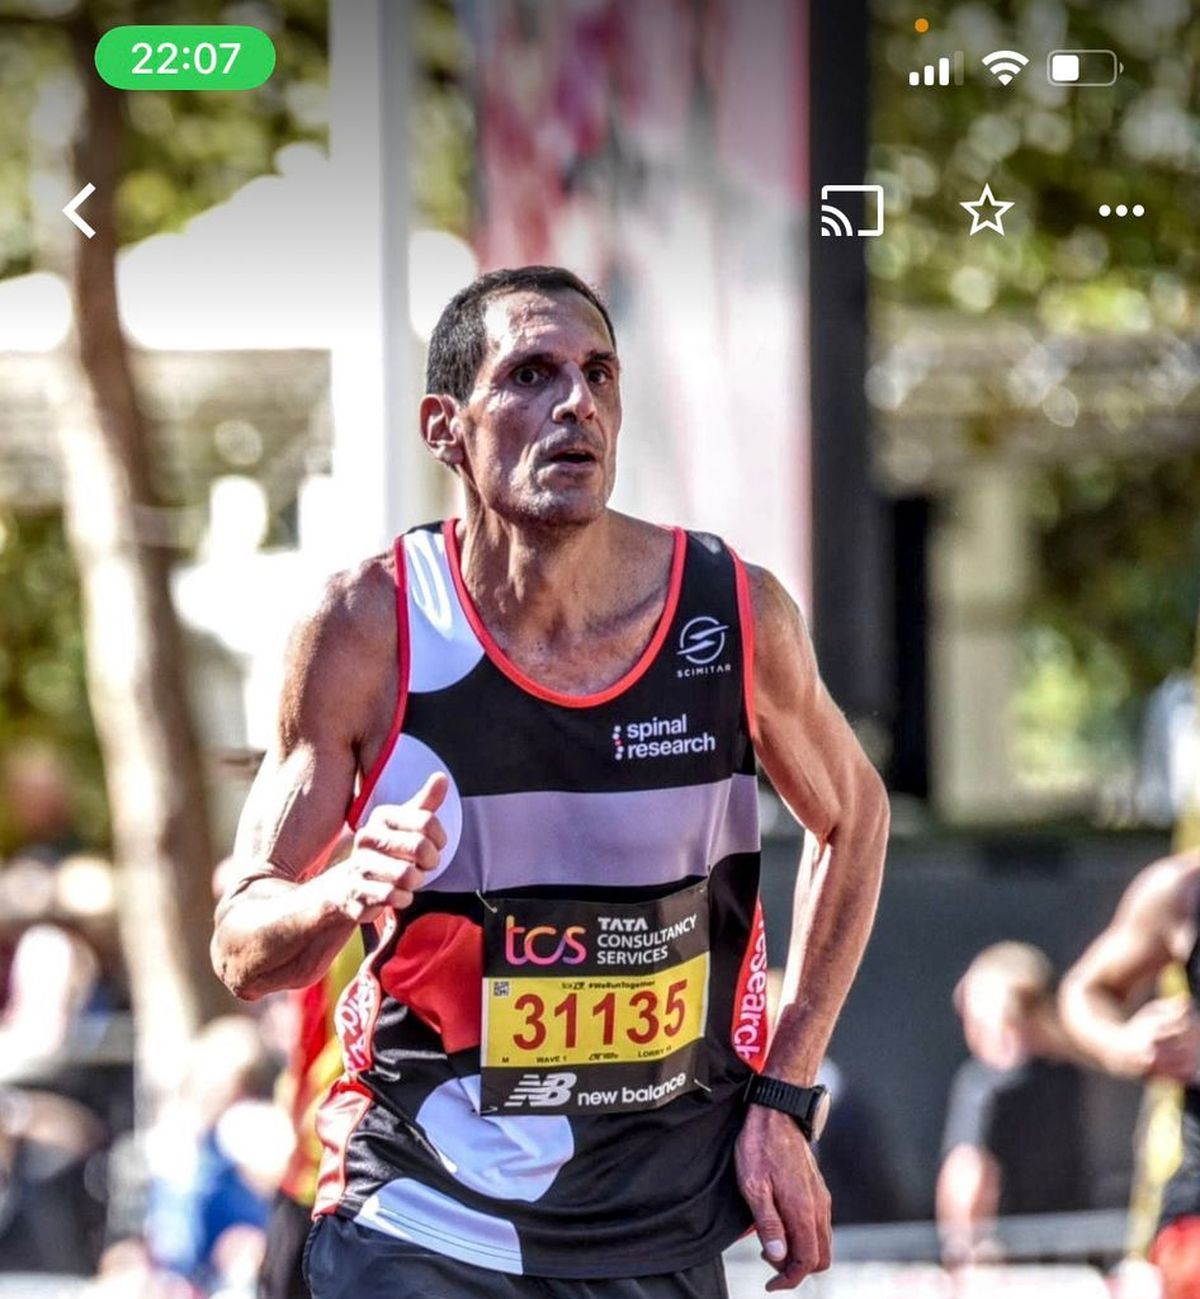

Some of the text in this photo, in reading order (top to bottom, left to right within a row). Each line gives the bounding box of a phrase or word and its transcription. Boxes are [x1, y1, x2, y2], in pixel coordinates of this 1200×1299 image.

[677, 664, 731, 678] SCIMITAR
[627, 713, 687, 742] spinal
[627, 732, 716, 759] research
[597, 916, 648, 931] TATA
[597, 913, 698, 948] CONSULTANCY
[505, 915, 588, 966] tcs
[597, 945, 669, 965] SERVICES
[512, 978, 688, 1051] 31135
[501, 1056, 510, 1064] M
[535, 1055, 561, 1064] WAVE
[577, 1072, 687, 1107] new balance
